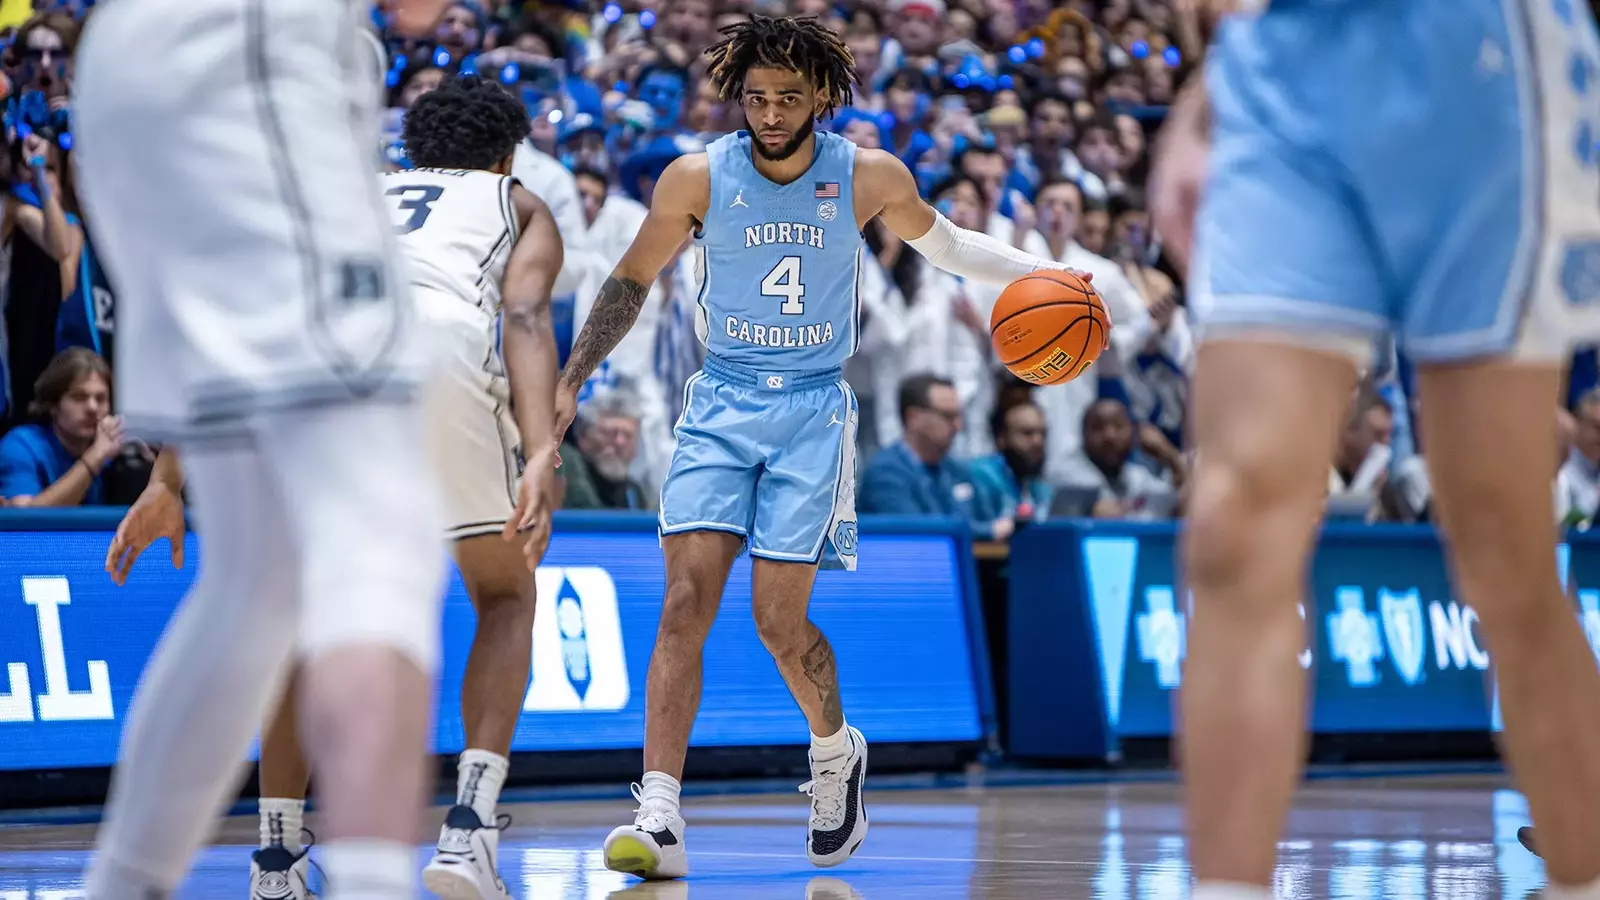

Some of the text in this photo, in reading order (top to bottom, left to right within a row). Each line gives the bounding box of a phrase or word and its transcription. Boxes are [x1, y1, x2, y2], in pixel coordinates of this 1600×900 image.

[385, 184, 445, 235] 3
[744, 222, 825, 249] NORTH
[760, 255, 805, 315] 4
[725, 315, 834, 348] CAROLINA
[1429, 600, 1490, 670] NC
